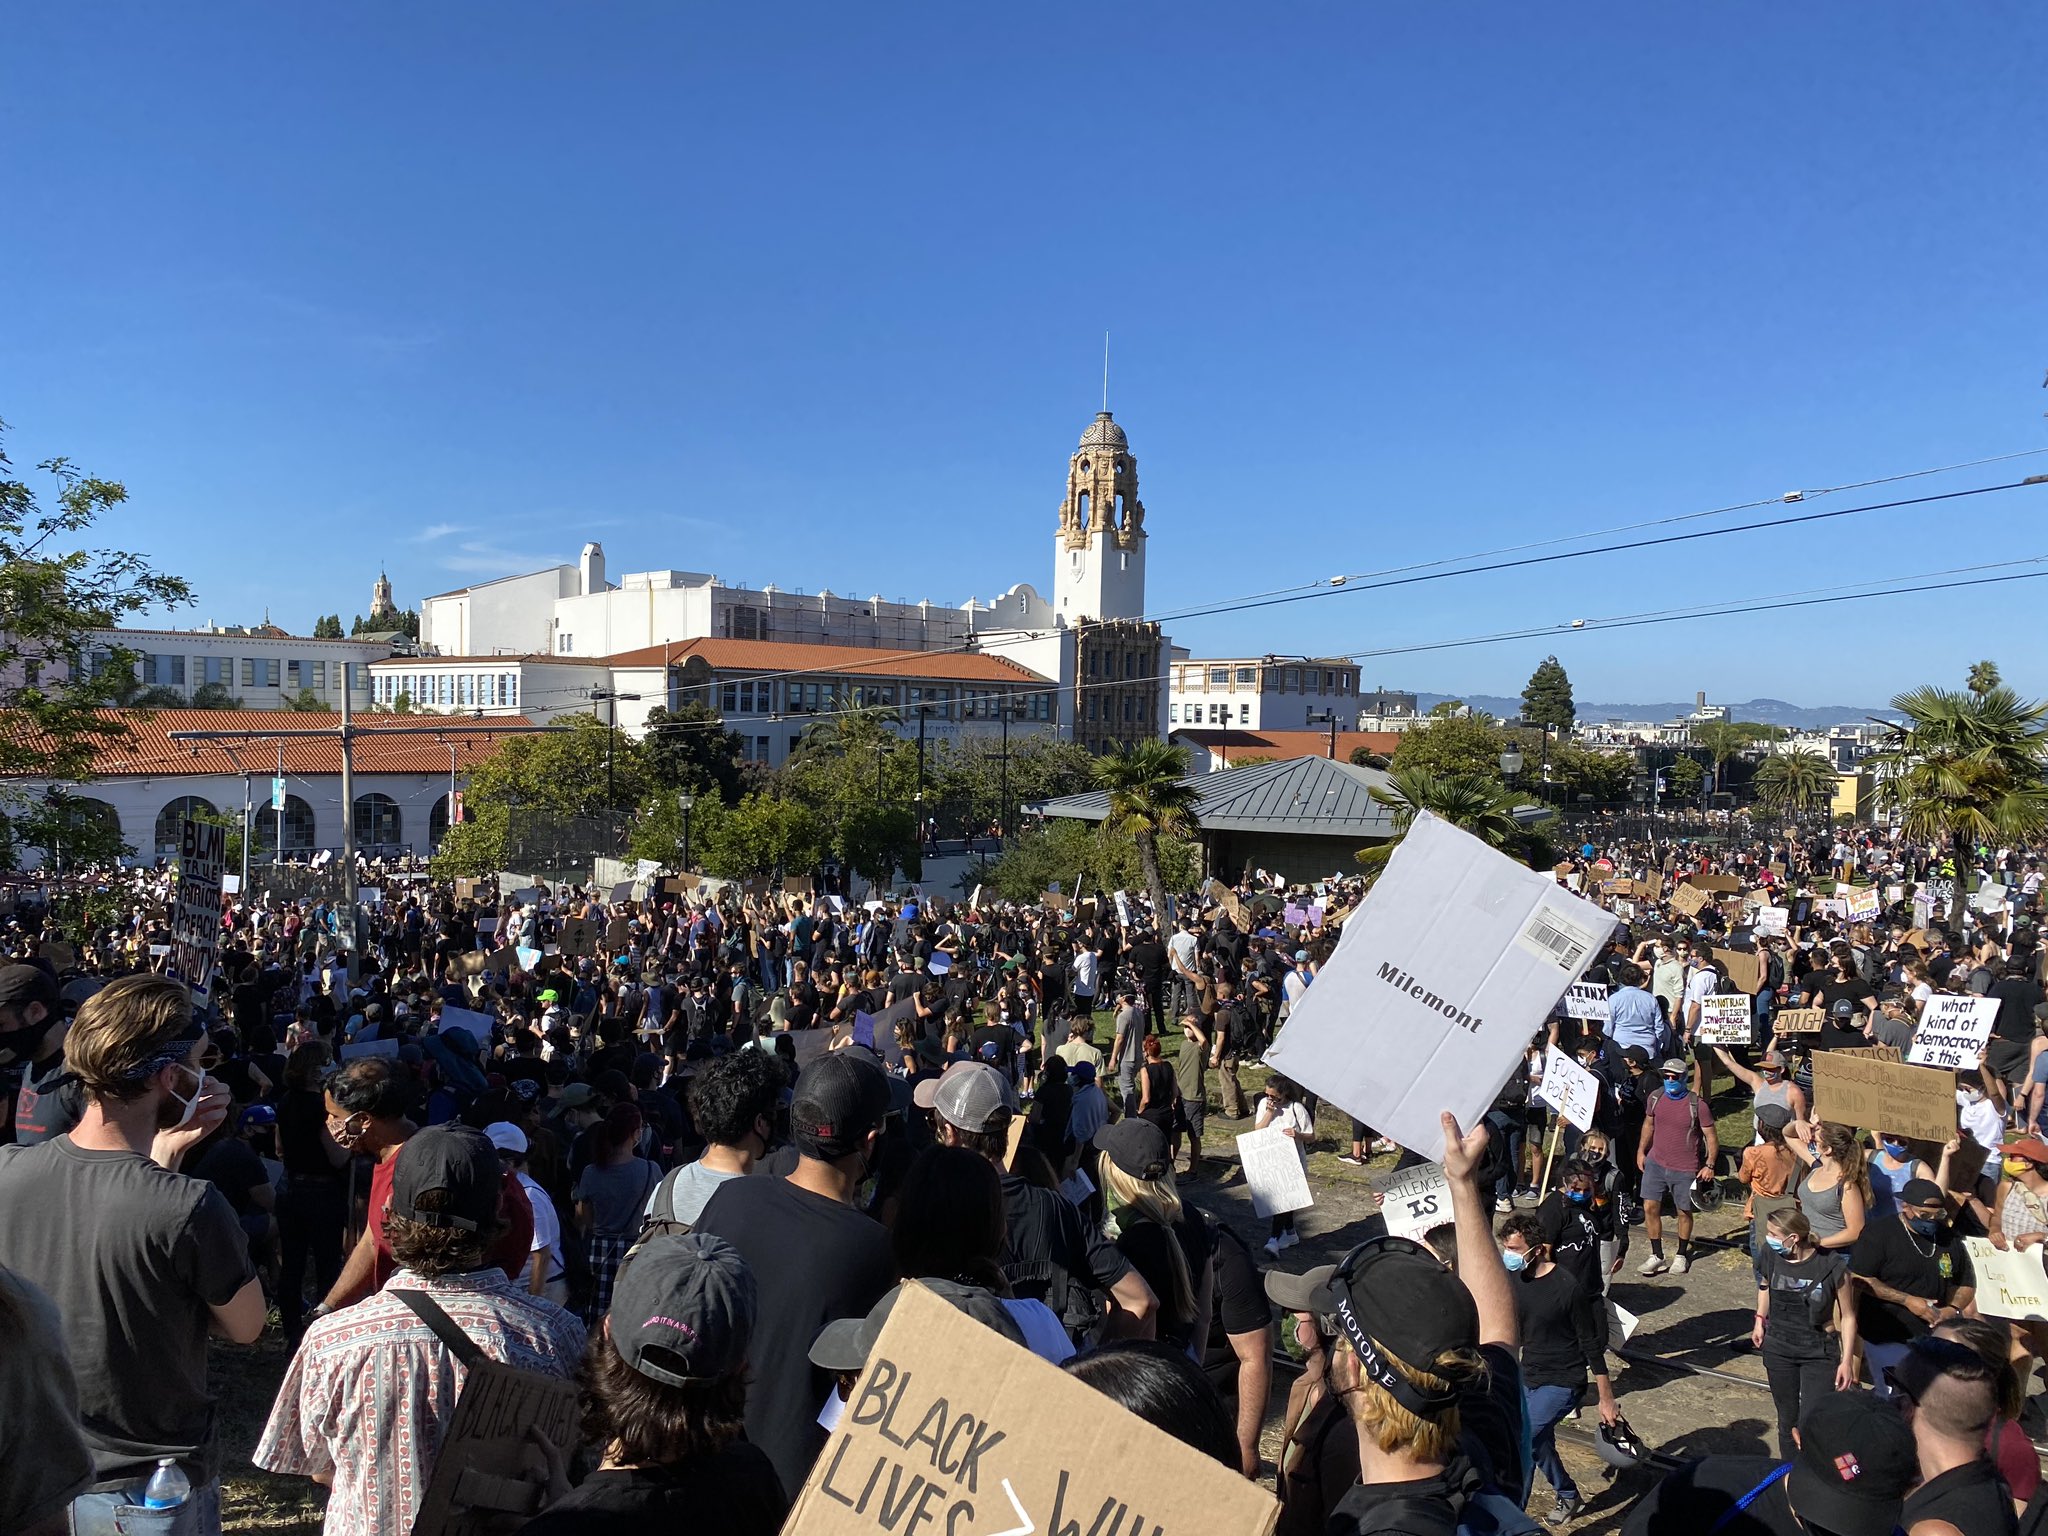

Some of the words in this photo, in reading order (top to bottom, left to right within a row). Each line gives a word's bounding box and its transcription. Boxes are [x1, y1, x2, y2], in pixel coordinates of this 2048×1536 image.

[184, 859, 218, 880] TRUE
[1679, 885, 1707, 905] ABOLISH
[1927, 879, 1955, 889] BLACK
[1673, 893, 1690, 907] COPS
[176, 908, 218, 942] PREACH
[1376, 961, 1483, 1034] Milemont
[1566, 985, 1608, 1001] ATINX
[1730, 997, 1746, 1008] BLACK
[1941, 999, 1976, 1013] what
[1779, 1012, 1823, 1031] ENOUGH
[1926, 1015, 1958, 1030] kind
[1961, 1018, 1978, 1032] of
[1915, 1029, 1985, 1055] democracy
[1923, 1048, 1934, 1062] is
[1938, 1049, 1962, 1066] this
[1552, 1057, 1587, 1091] FUCK
[1546, 1080, 1588, 1121] POLICE
[1815, 1085, 1866, 1112] FUND
[1380, 1163, 1437, 1187] WHITE
[1386, 1175, 1446, 1202] SILENCE
[1406, 1194, 1438, 1219] IS
[456, 1370, 533, 1442] BLACK
[851, 1357, 1006, 1494] BLACK
[821, 1433, 975, 1536] LIVES
